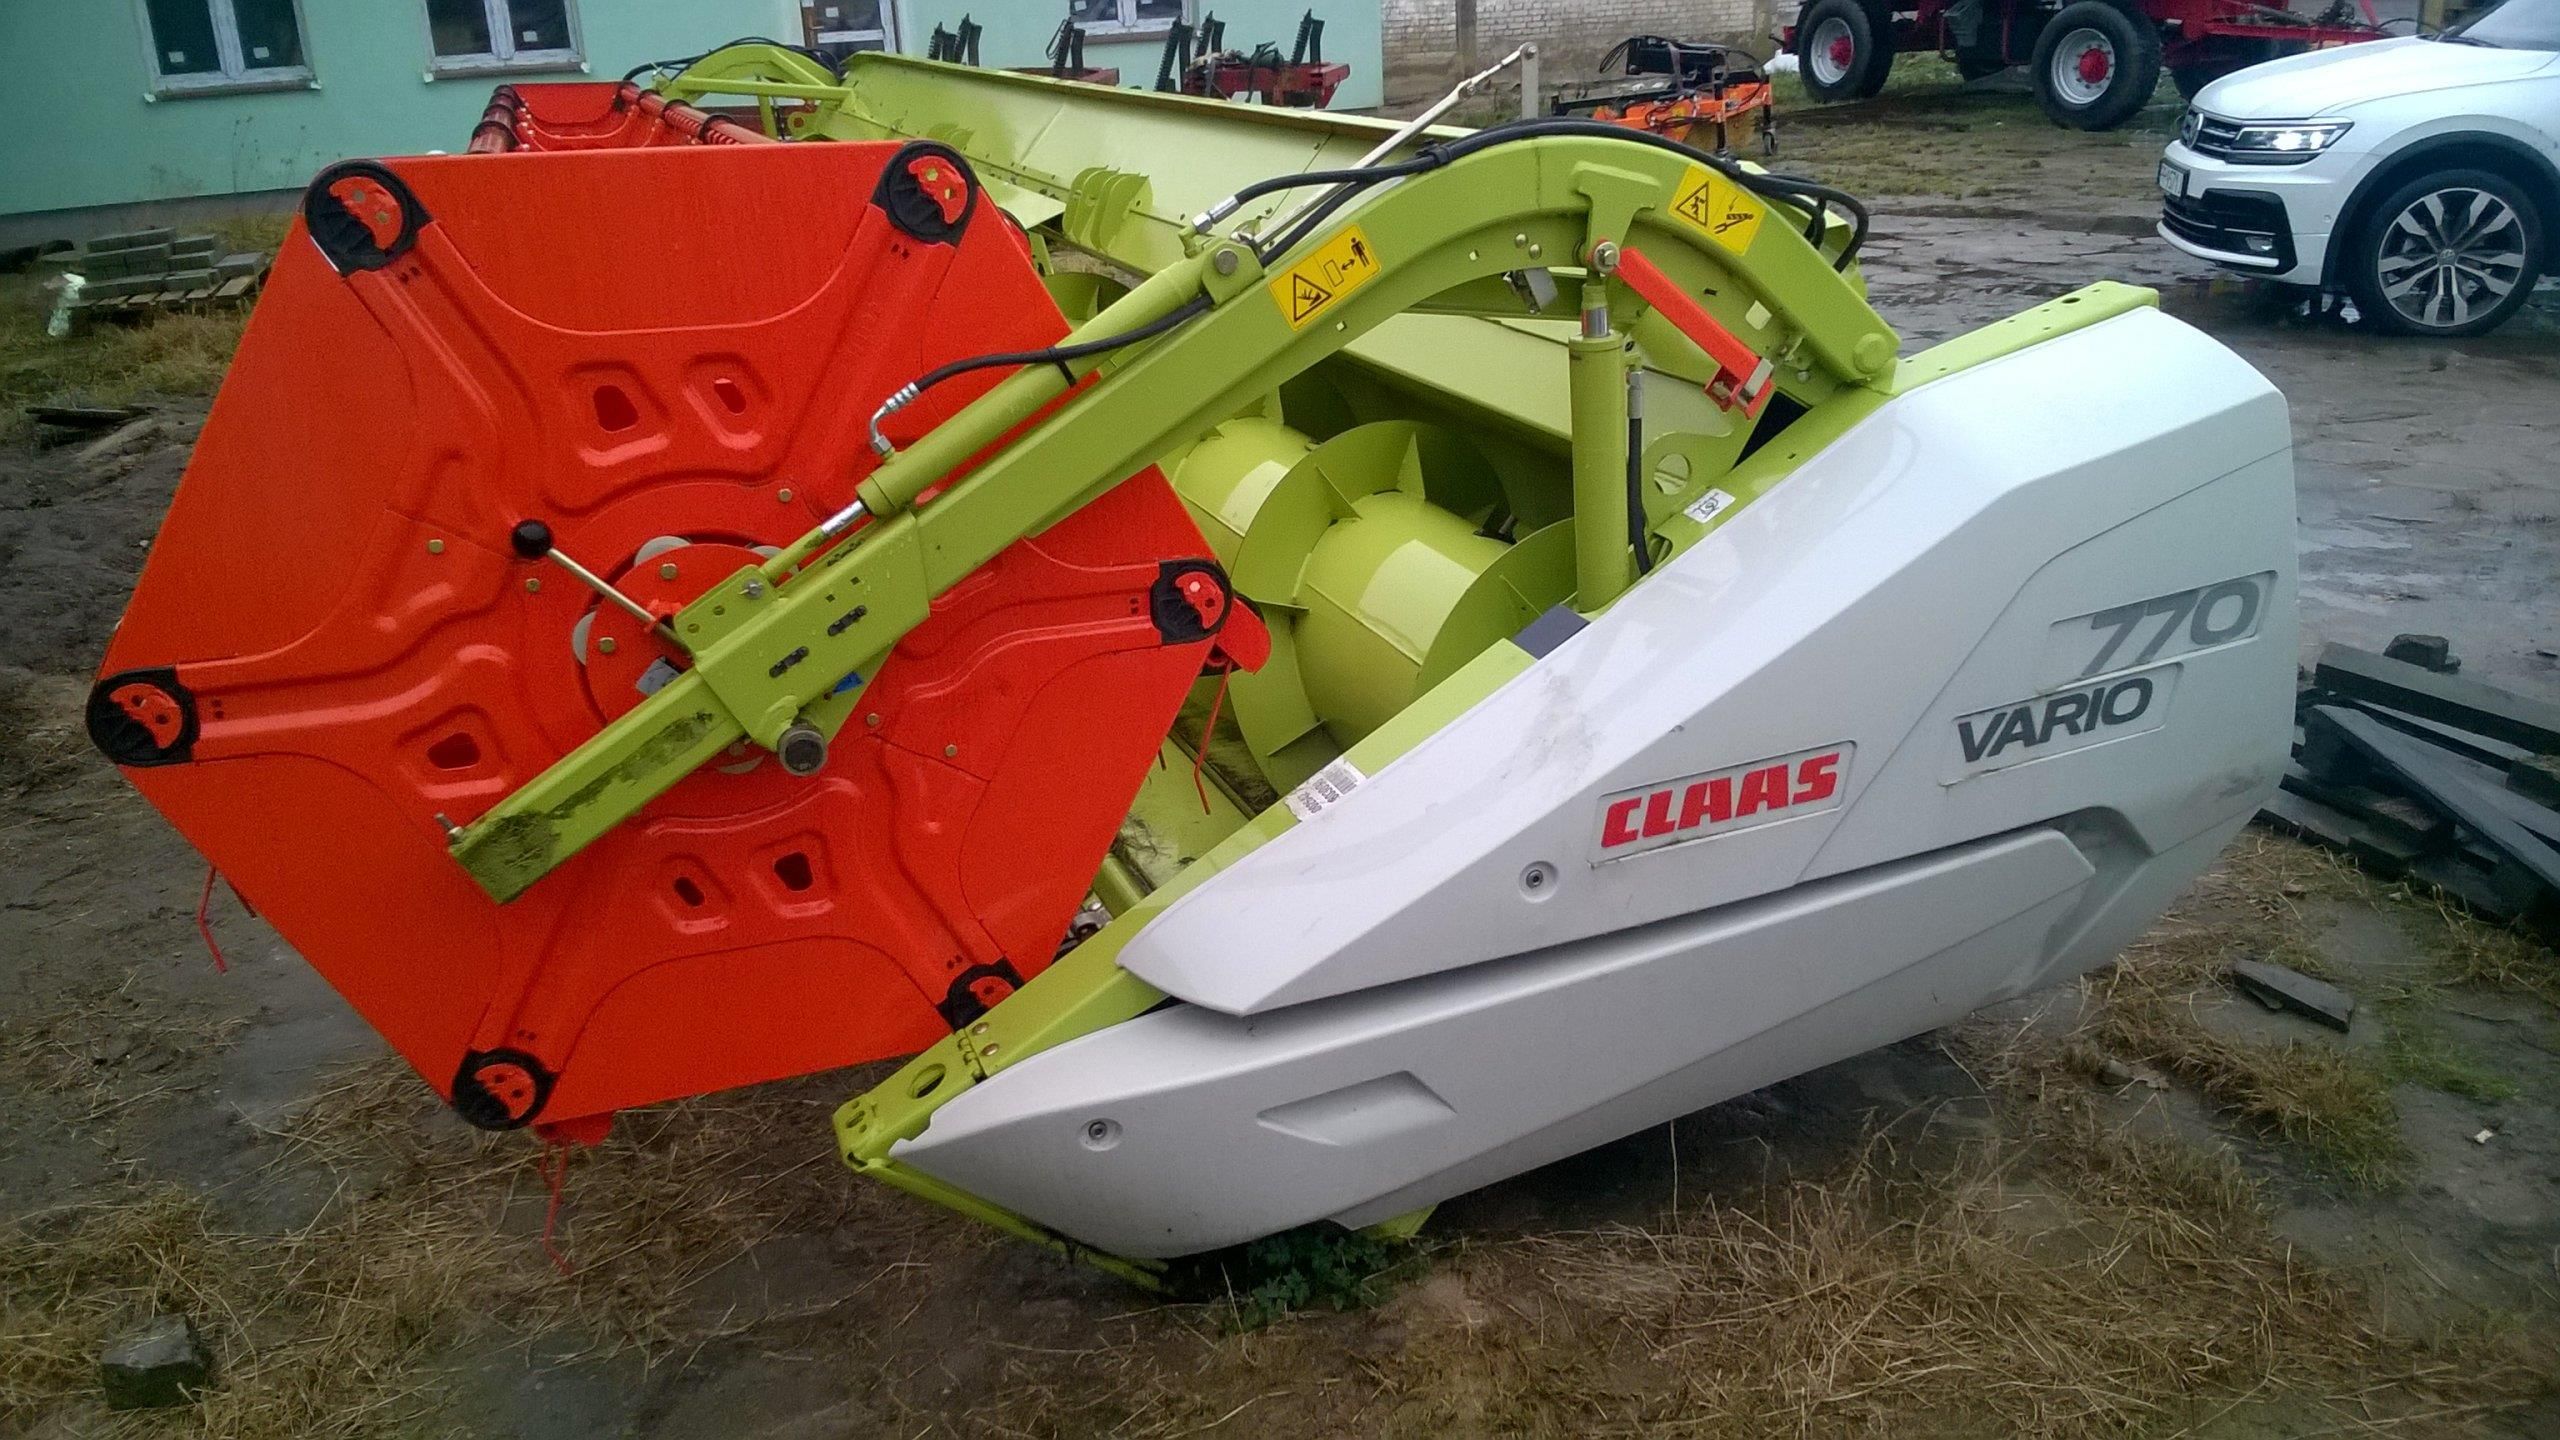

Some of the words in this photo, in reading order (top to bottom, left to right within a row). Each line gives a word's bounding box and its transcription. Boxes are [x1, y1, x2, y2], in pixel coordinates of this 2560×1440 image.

[2081, 581, 2260, 677] 770
[1957, 677, 2153, 763] VARIO
[1601, 752, 1840, 848] CLAAS
